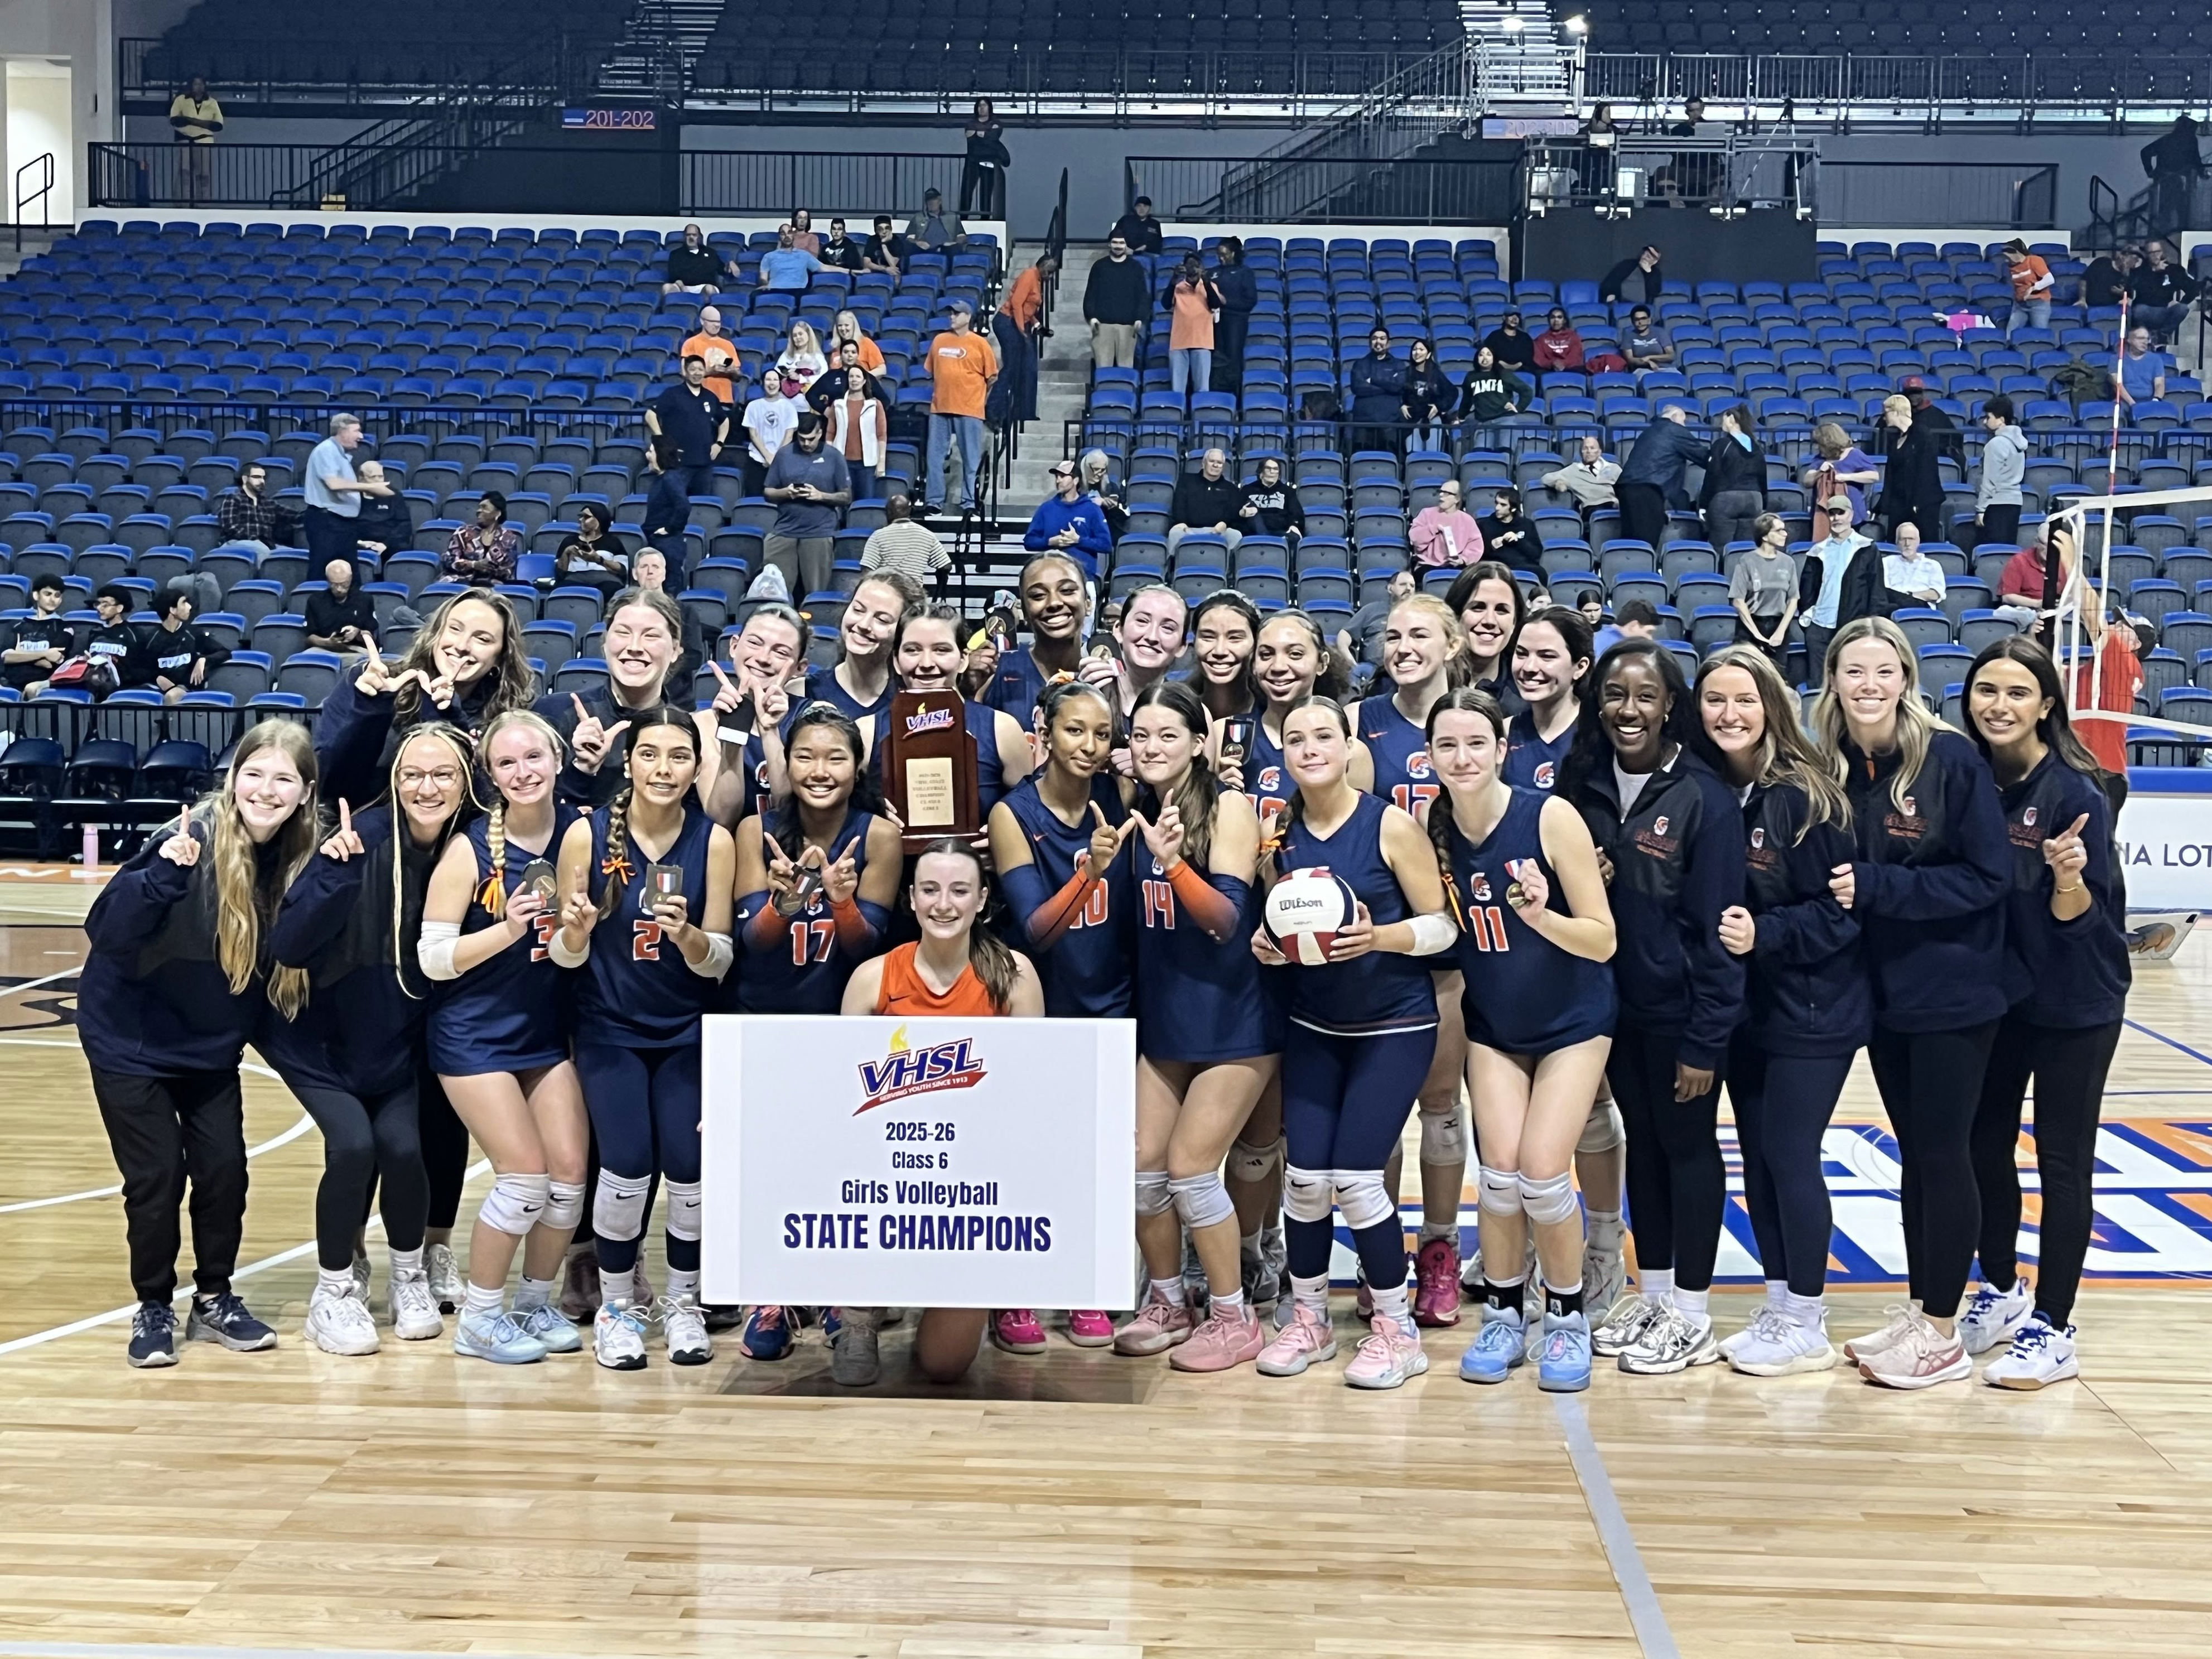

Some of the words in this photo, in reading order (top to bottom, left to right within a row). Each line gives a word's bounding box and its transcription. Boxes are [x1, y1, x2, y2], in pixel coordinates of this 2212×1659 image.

[586, 110, 654, 127] 201-202
[906, 708, 953, 730] VHSL
[2118, 842, 2152, 866] IA
[1142, 879, 1175, 929] 14
[1279, 898, 1323, 911] Wilson
[633, 919, 662, 961] 2
[791, 919, 836, 966] 17
[1469, 905, 1509, 952] 11
[860, 1039, 981, 1095] VHSL
[886, 1122, 955, 1141] 2025-26
[893, 1151, 934, 1169] Class
[939, 1152, 948, 1169] 6
[842, 1179, 889, 1204] Girls
[895, 1180, 998, 1208] Volleyball
[784, 1213, 868, 1249] STATE
[879, 1214, 1051, 1252] CHAMPIONS
